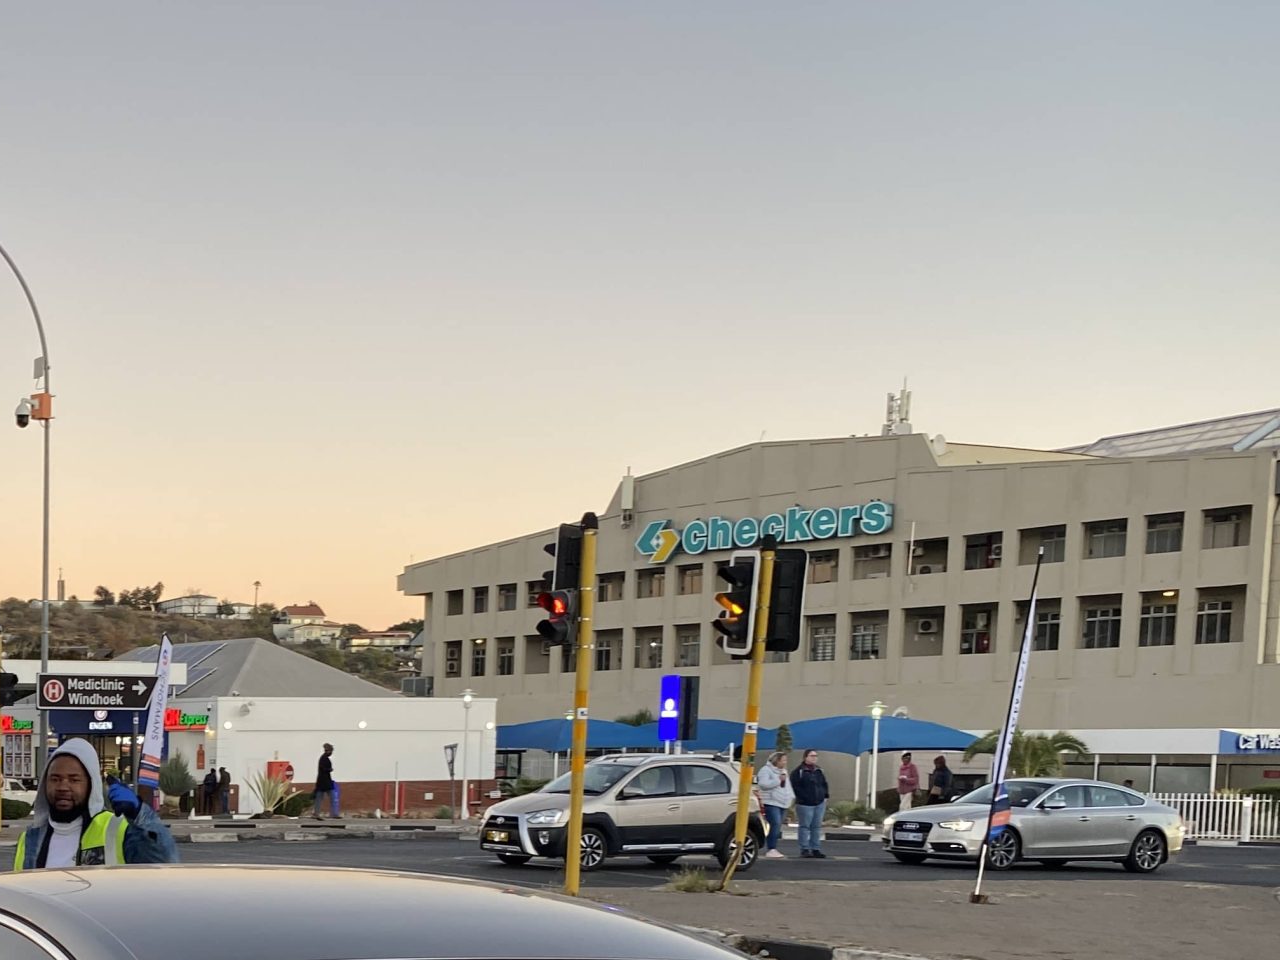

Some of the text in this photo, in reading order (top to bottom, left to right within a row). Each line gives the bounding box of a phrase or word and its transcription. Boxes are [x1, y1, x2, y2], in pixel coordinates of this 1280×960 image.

[67, 678, 125, 690] Mediclinic
[67, 693, 124, 705] Windhoek
[181, 714, 209, 727] Express
[1239, 735, 1259, 750] Car
